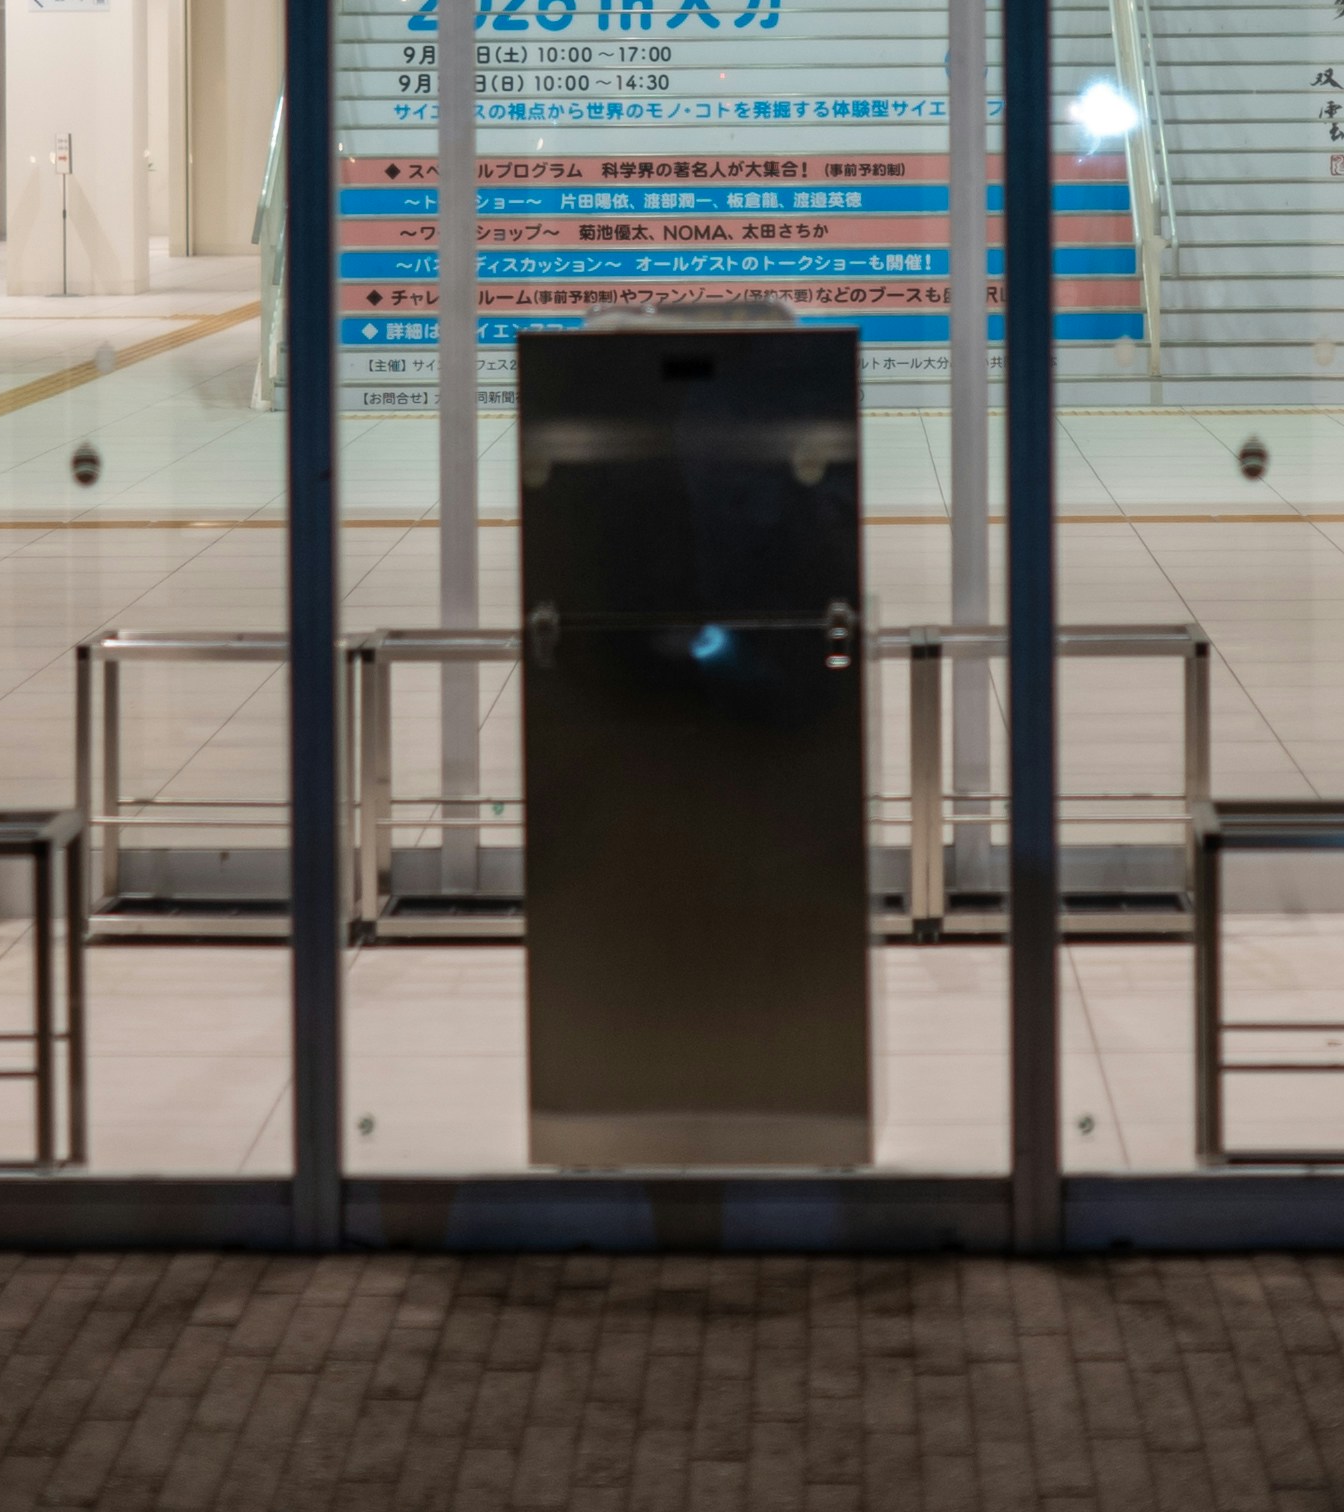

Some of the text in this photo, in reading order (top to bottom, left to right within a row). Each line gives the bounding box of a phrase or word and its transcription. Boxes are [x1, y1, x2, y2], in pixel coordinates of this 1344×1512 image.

[403, 45, 529, 65] 9月日(土)
[398, 74, 525, 94] 9月日(日)
[408, 162, 583, 179] スペルプログラム
[404, 193, 543, 211] 〜トショー〜
[400, 223, 560, 241] 〜ワショップ〜
[396, 256, 622, 274] 〜パディスカッション〜
